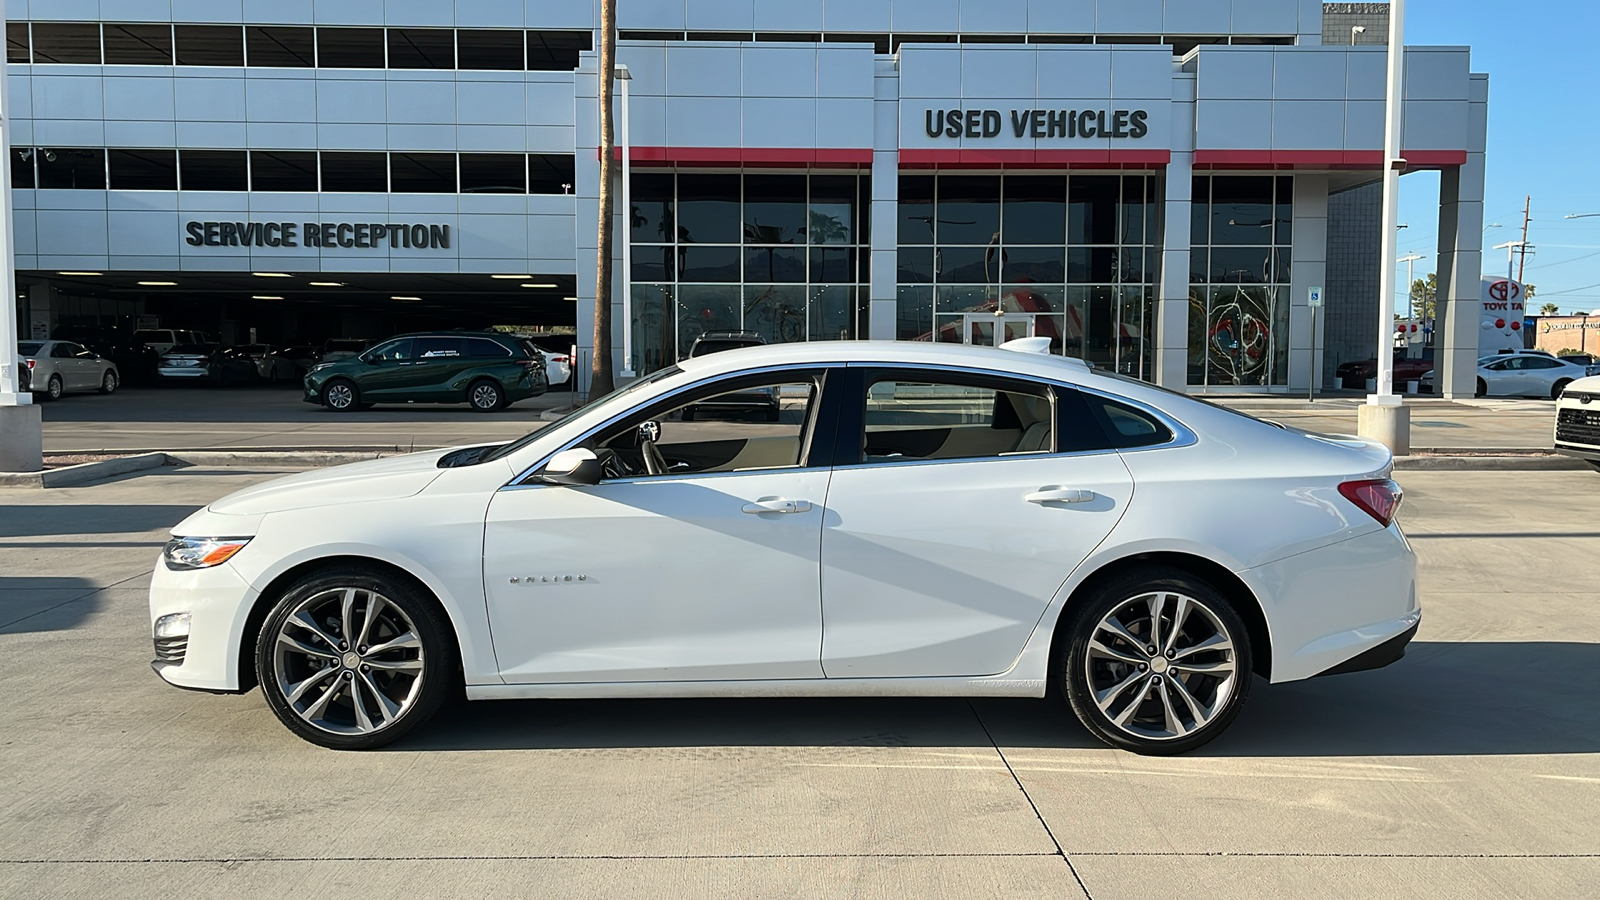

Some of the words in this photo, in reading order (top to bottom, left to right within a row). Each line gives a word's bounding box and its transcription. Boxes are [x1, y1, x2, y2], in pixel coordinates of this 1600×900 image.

[925, 109, 1001, 138] USED
[1011, 109, 1148, 138] VEHICLES
[186, 221, 298, 247] SERVICE
[303, 223, 450, 249] RECEPTION
[508, 574, 587, 584] MALIBU
